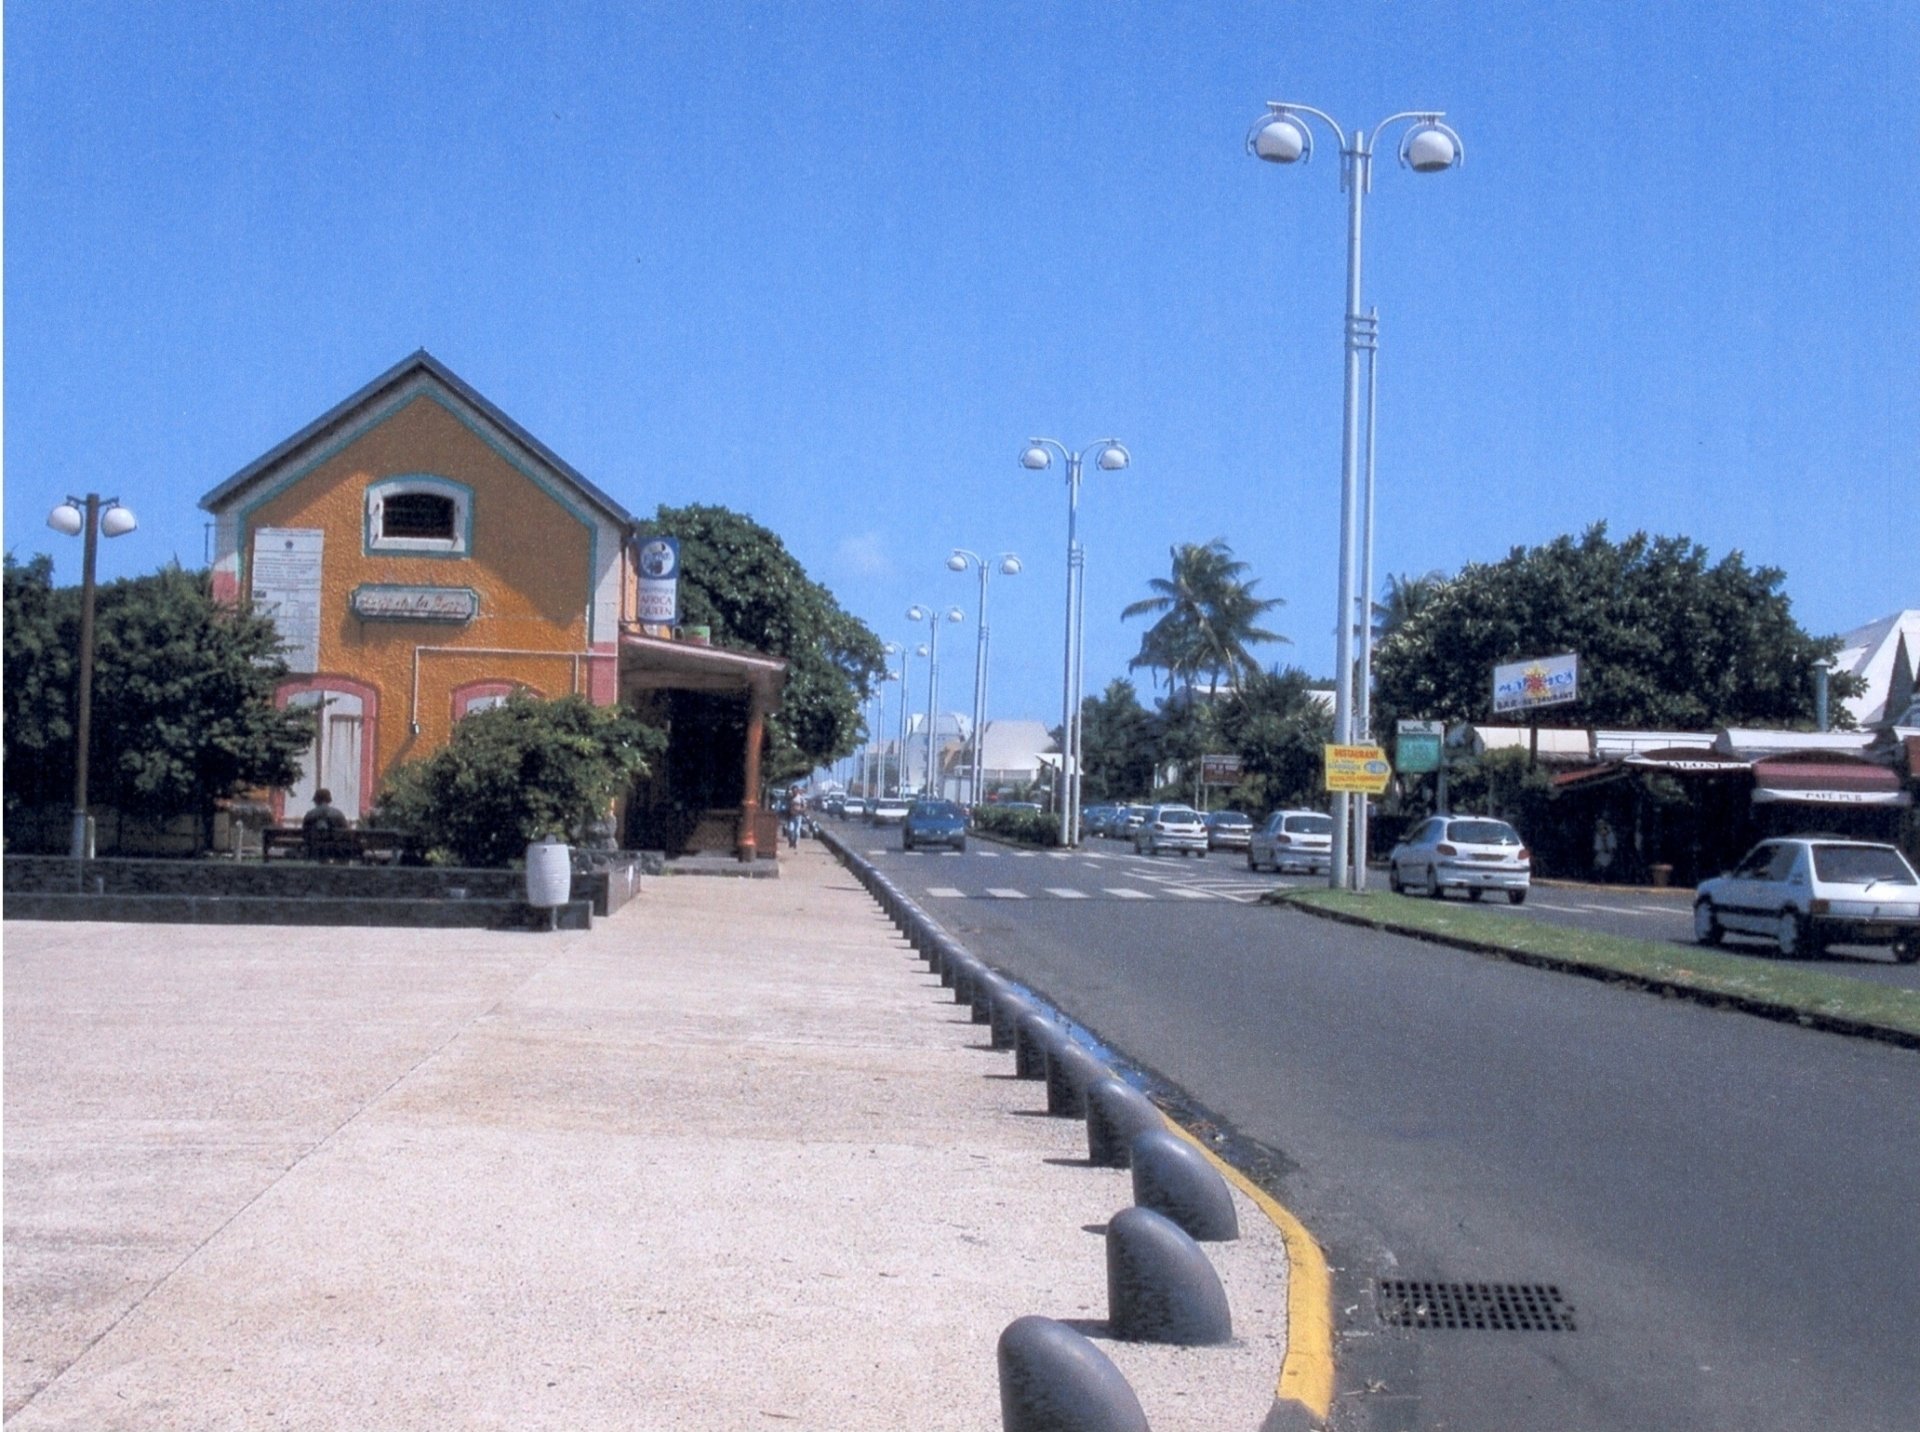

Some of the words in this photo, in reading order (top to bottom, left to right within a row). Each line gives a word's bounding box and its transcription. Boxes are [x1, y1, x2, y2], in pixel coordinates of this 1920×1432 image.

[641, 595, 673, 605] AFRICA
[641, 606, 672, 617] QUEEN
[1523, 691, 1574, 705] RETAURANT
[1838, 793, 1862, 802] PUB
